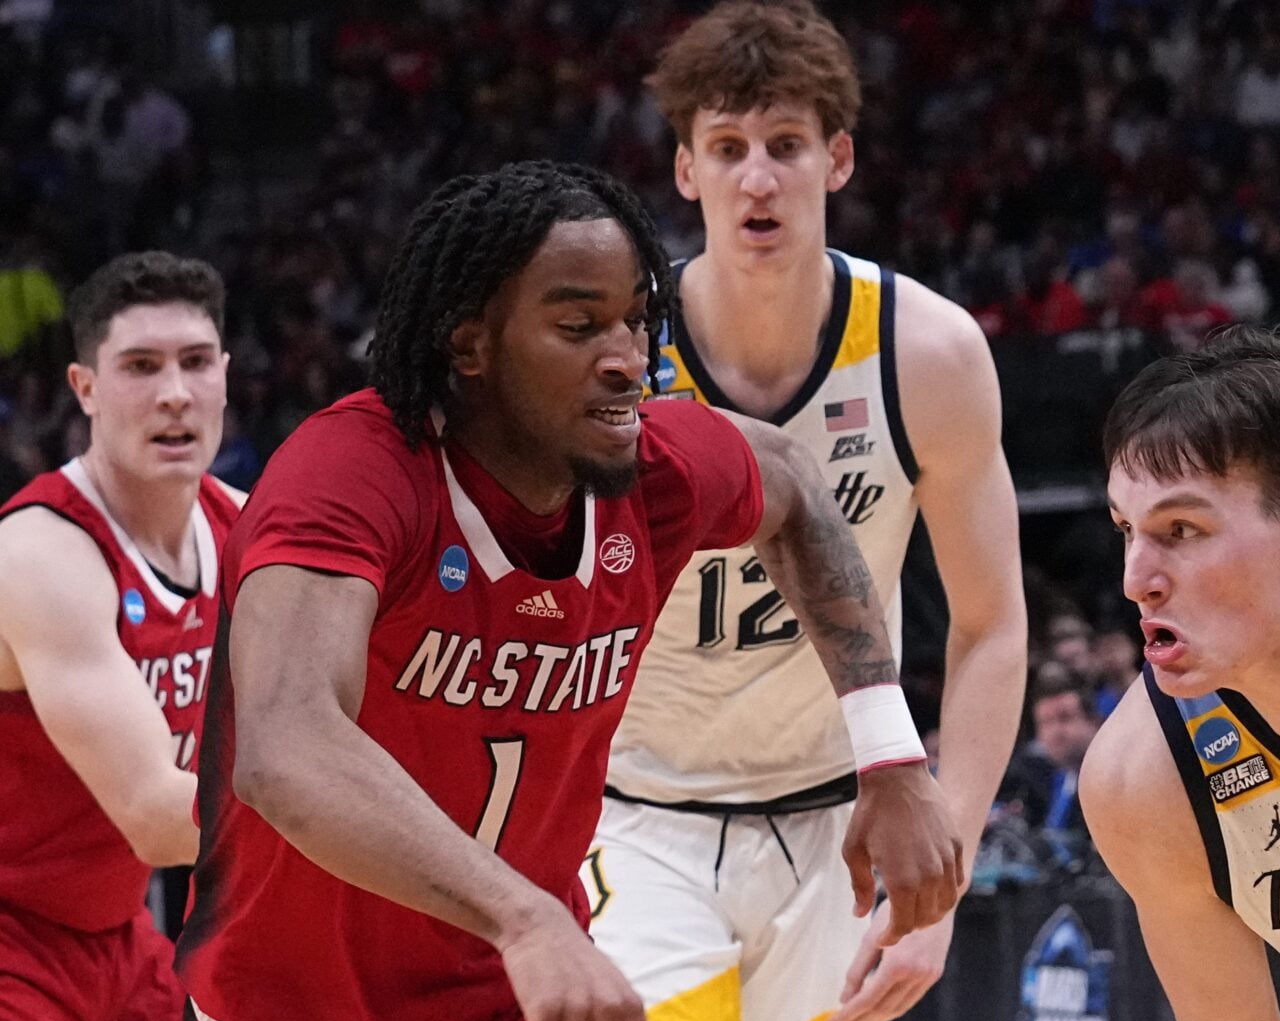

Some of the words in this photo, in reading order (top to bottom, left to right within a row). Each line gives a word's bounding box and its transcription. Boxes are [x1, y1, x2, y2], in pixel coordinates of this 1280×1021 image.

[603, 543, 635, 560] ACC
[441, 563, 467, 583] NCAA
[516, 602, 565, 619] adidas
[696, 556, 806, 651] 12
[480, 626, 641, 713] STATE
[1203, 730, 1240, 760] NCAA
[475, 733, 527, 854] 1
[1215, 768, 1270, 800] CHANGE
